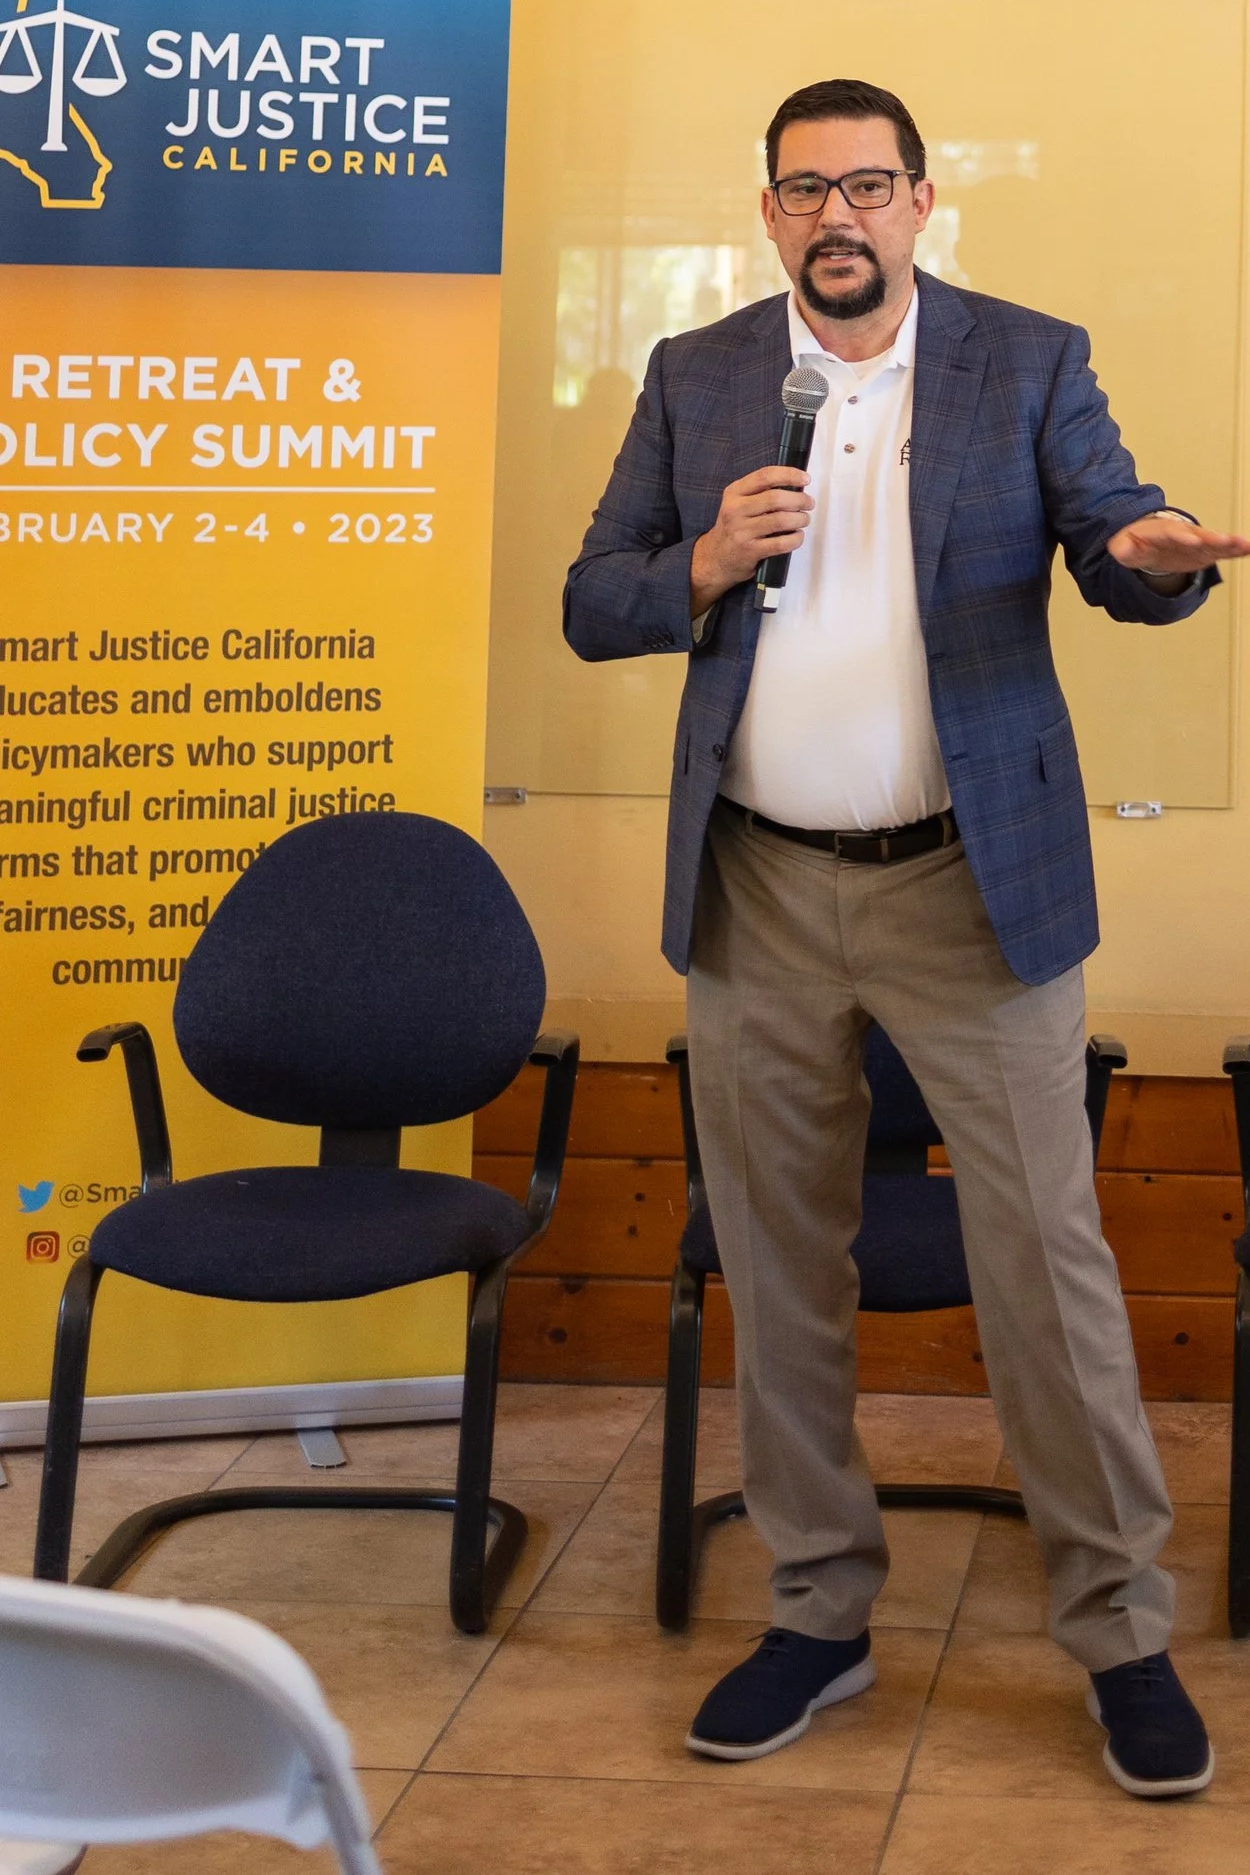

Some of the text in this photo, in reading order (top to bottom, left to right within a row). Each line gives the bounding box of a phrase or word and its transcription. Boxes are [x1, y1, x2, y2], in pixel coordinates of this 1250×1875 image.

[145, 29, 385, 86] SMART
[165, 88, 451, 145] JUSTICE
[162, 146, 449, 177] CALIFORNIA
[11, 354, 362, 403] RETREAT &
[191, 423, 437, 470] SUMMIT
[194, 512, 270, 544] 2-4
[327, 512, 434, 544] 2023
[0, 628, 376, 662] mart Justice California
[0, 681, 382, 716] ucates and emboldens
[2, 733, 394, 777] icymakers who support
[0, 786, 396, 830] aningful criminal justice
[71, 844, 139, 877] that
[148, 896, 209, 928] and
[52, 957, 190, 986] commu
